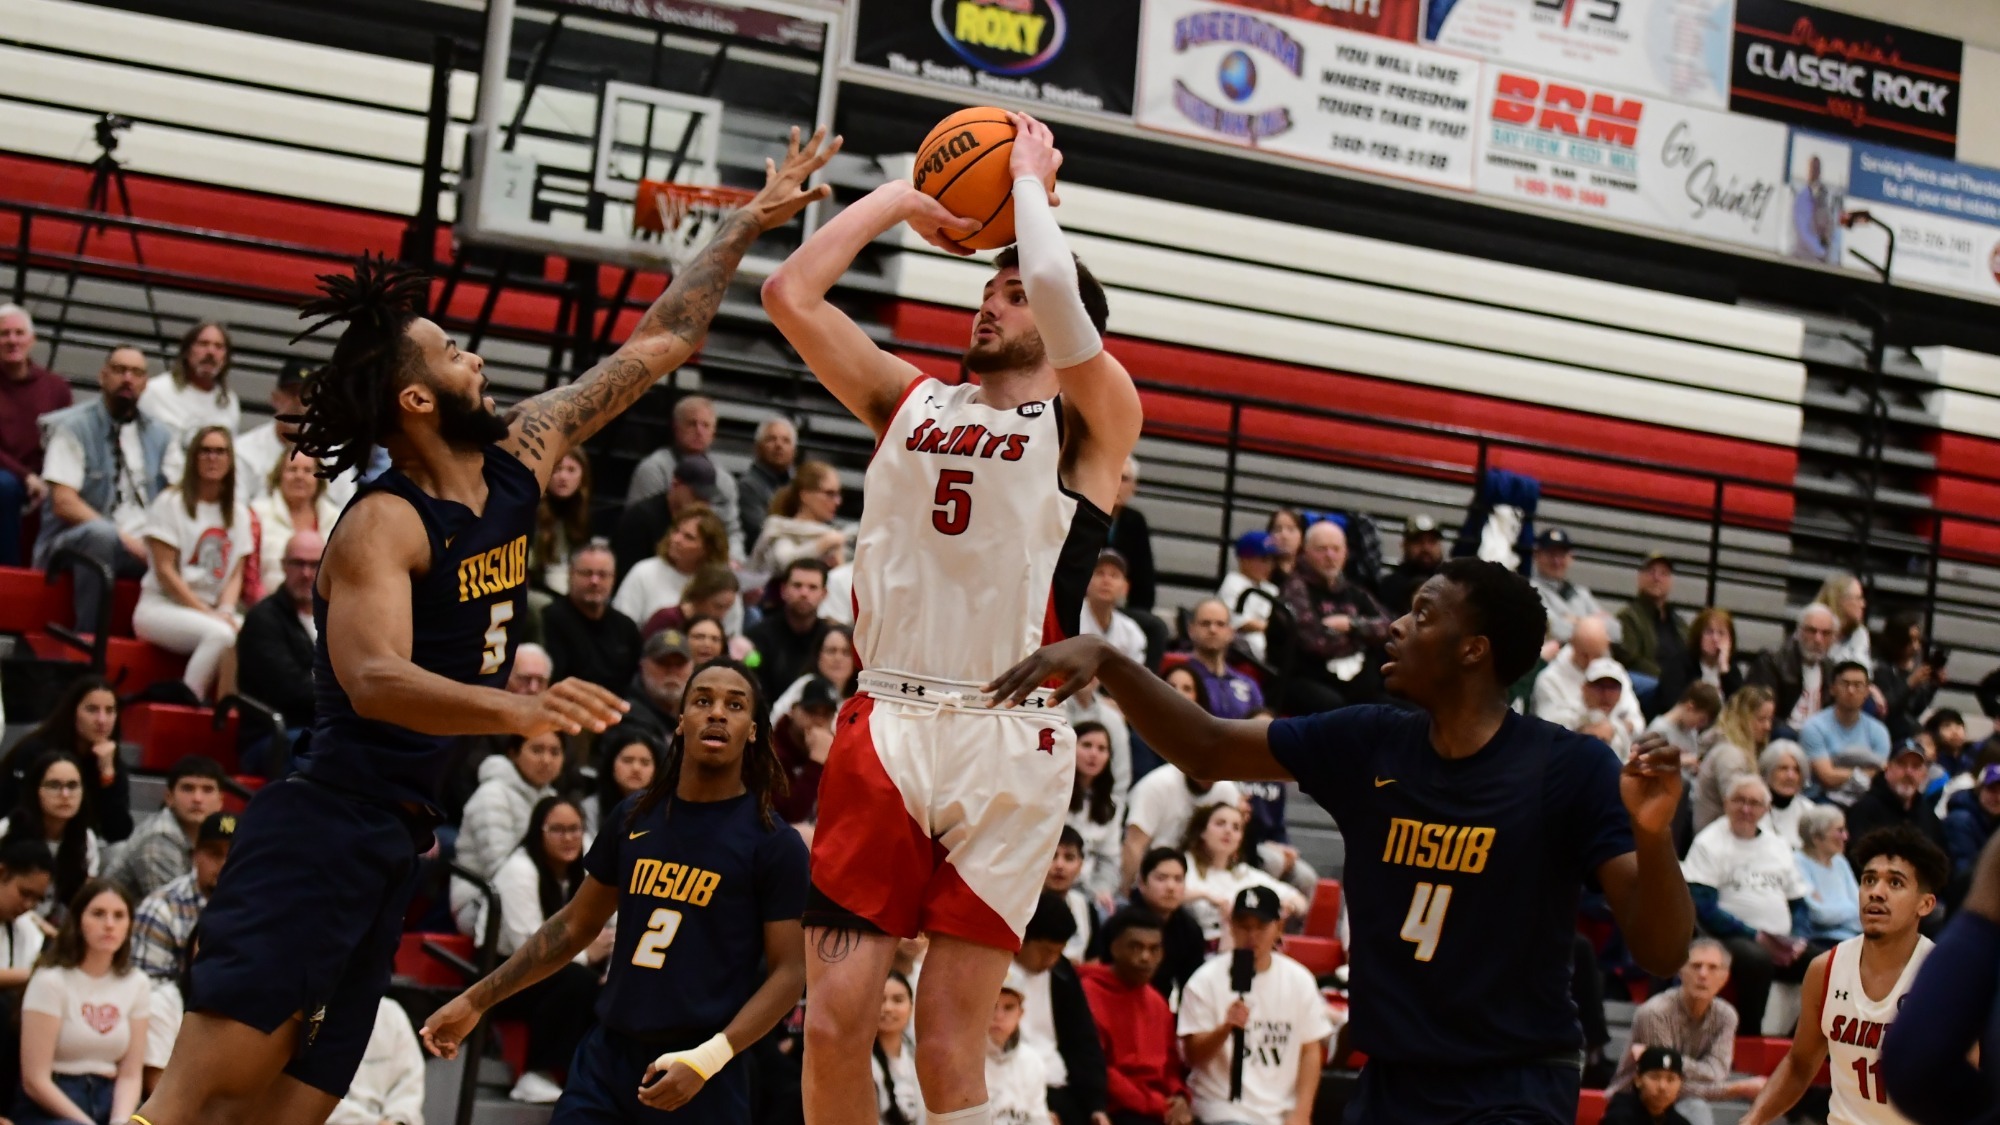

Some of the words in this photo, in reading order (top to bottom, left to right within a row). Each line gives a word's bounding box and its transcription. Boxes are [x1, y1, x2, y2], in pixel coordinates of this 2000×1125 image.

[955, 2, 1046, 56] ROXY
[887, 53, 919, 74] The
[921, 59, 973, 86] South
[975, 70, 1039, 99] Sound's
[1041, 82, 1102, 109] Station
[1321, 69, 1381, 96] WHERE
[1385, 79, 1469, 113] FREEDOM
[1336, 44, 1370, 64] YOU
[1374, 50, 1411, 74] WILL
[1416, 58, 1460, 86] LOVE
[1745, 42, 1867, 98] CLASSIC
[1872, 71, 1949, 117] ROCK
[1318, 95, 1374, 122] TOURS
[1378, 104, 1422, 132] TAKE
[1491, 73, 1643, 149] BRM
[1661, 119, 1695, 169] Go
[1860, 152, 1905, 183] Serving
[1940, 170, 1960, 191] and
[1882, 177, 1900, 199] for
[1900, 182, 1915, 201] all
[1915, 189, 1942, 207] your
[1943, 192, 1962, 211] real
[906, 418, 1030, 461] SAINTS
[932, 468, 974, 536] 5
[458, 534, 527, 602] MSUB
[479, 600, 514, 675] 5
[1382, 817, 1496, 874] MSUB
[629, 858, 721, 907] MSUB
[631, 907, 682, 969] 2
[1400, 881, 1452, 962] 4
[1852, 1057, 1887, 1105] 11
